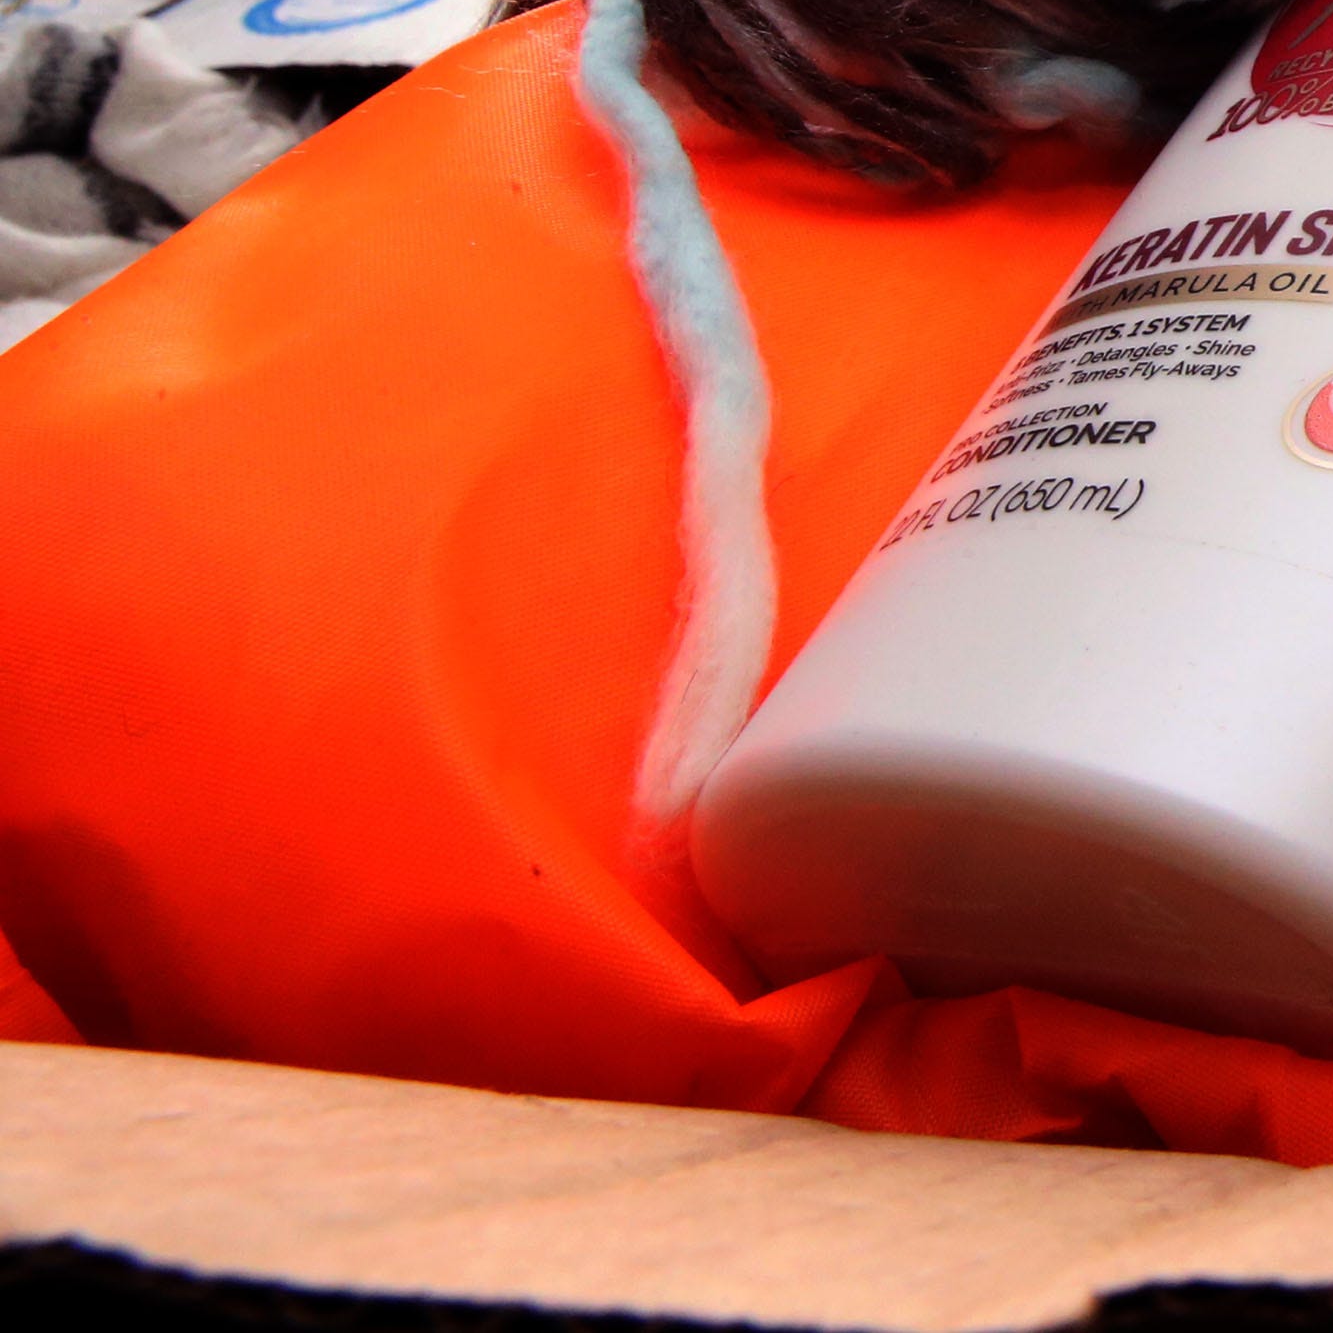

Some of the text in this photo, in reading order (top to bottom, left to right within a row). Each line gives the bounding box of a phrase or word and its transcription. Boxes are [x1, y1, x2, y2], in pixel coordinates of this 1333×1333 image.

[1067, 210, 1293, 299] KERATIN
[1111, 272, 1257, 307] MARULA
[1269, 270, 1332, 295] OIL
[1142, 314, 1251, 337] SYSTEM
[1076, 342, 1178, 366] Detangles
[1192, 340, 1256, 357] Shine
[984, 361, 1242, 414] Softness Tames Fly-Aways
[984, 402, 1108, 439] COLLECTION
[931, 420, 1157, 484] CONDITIONER
[910, 498, 947, 535] FL
[947, 485, 1002, 523] OZ
[990, 477, 1075, 522] (650
[1069, 478, 1145, 521] mL)
